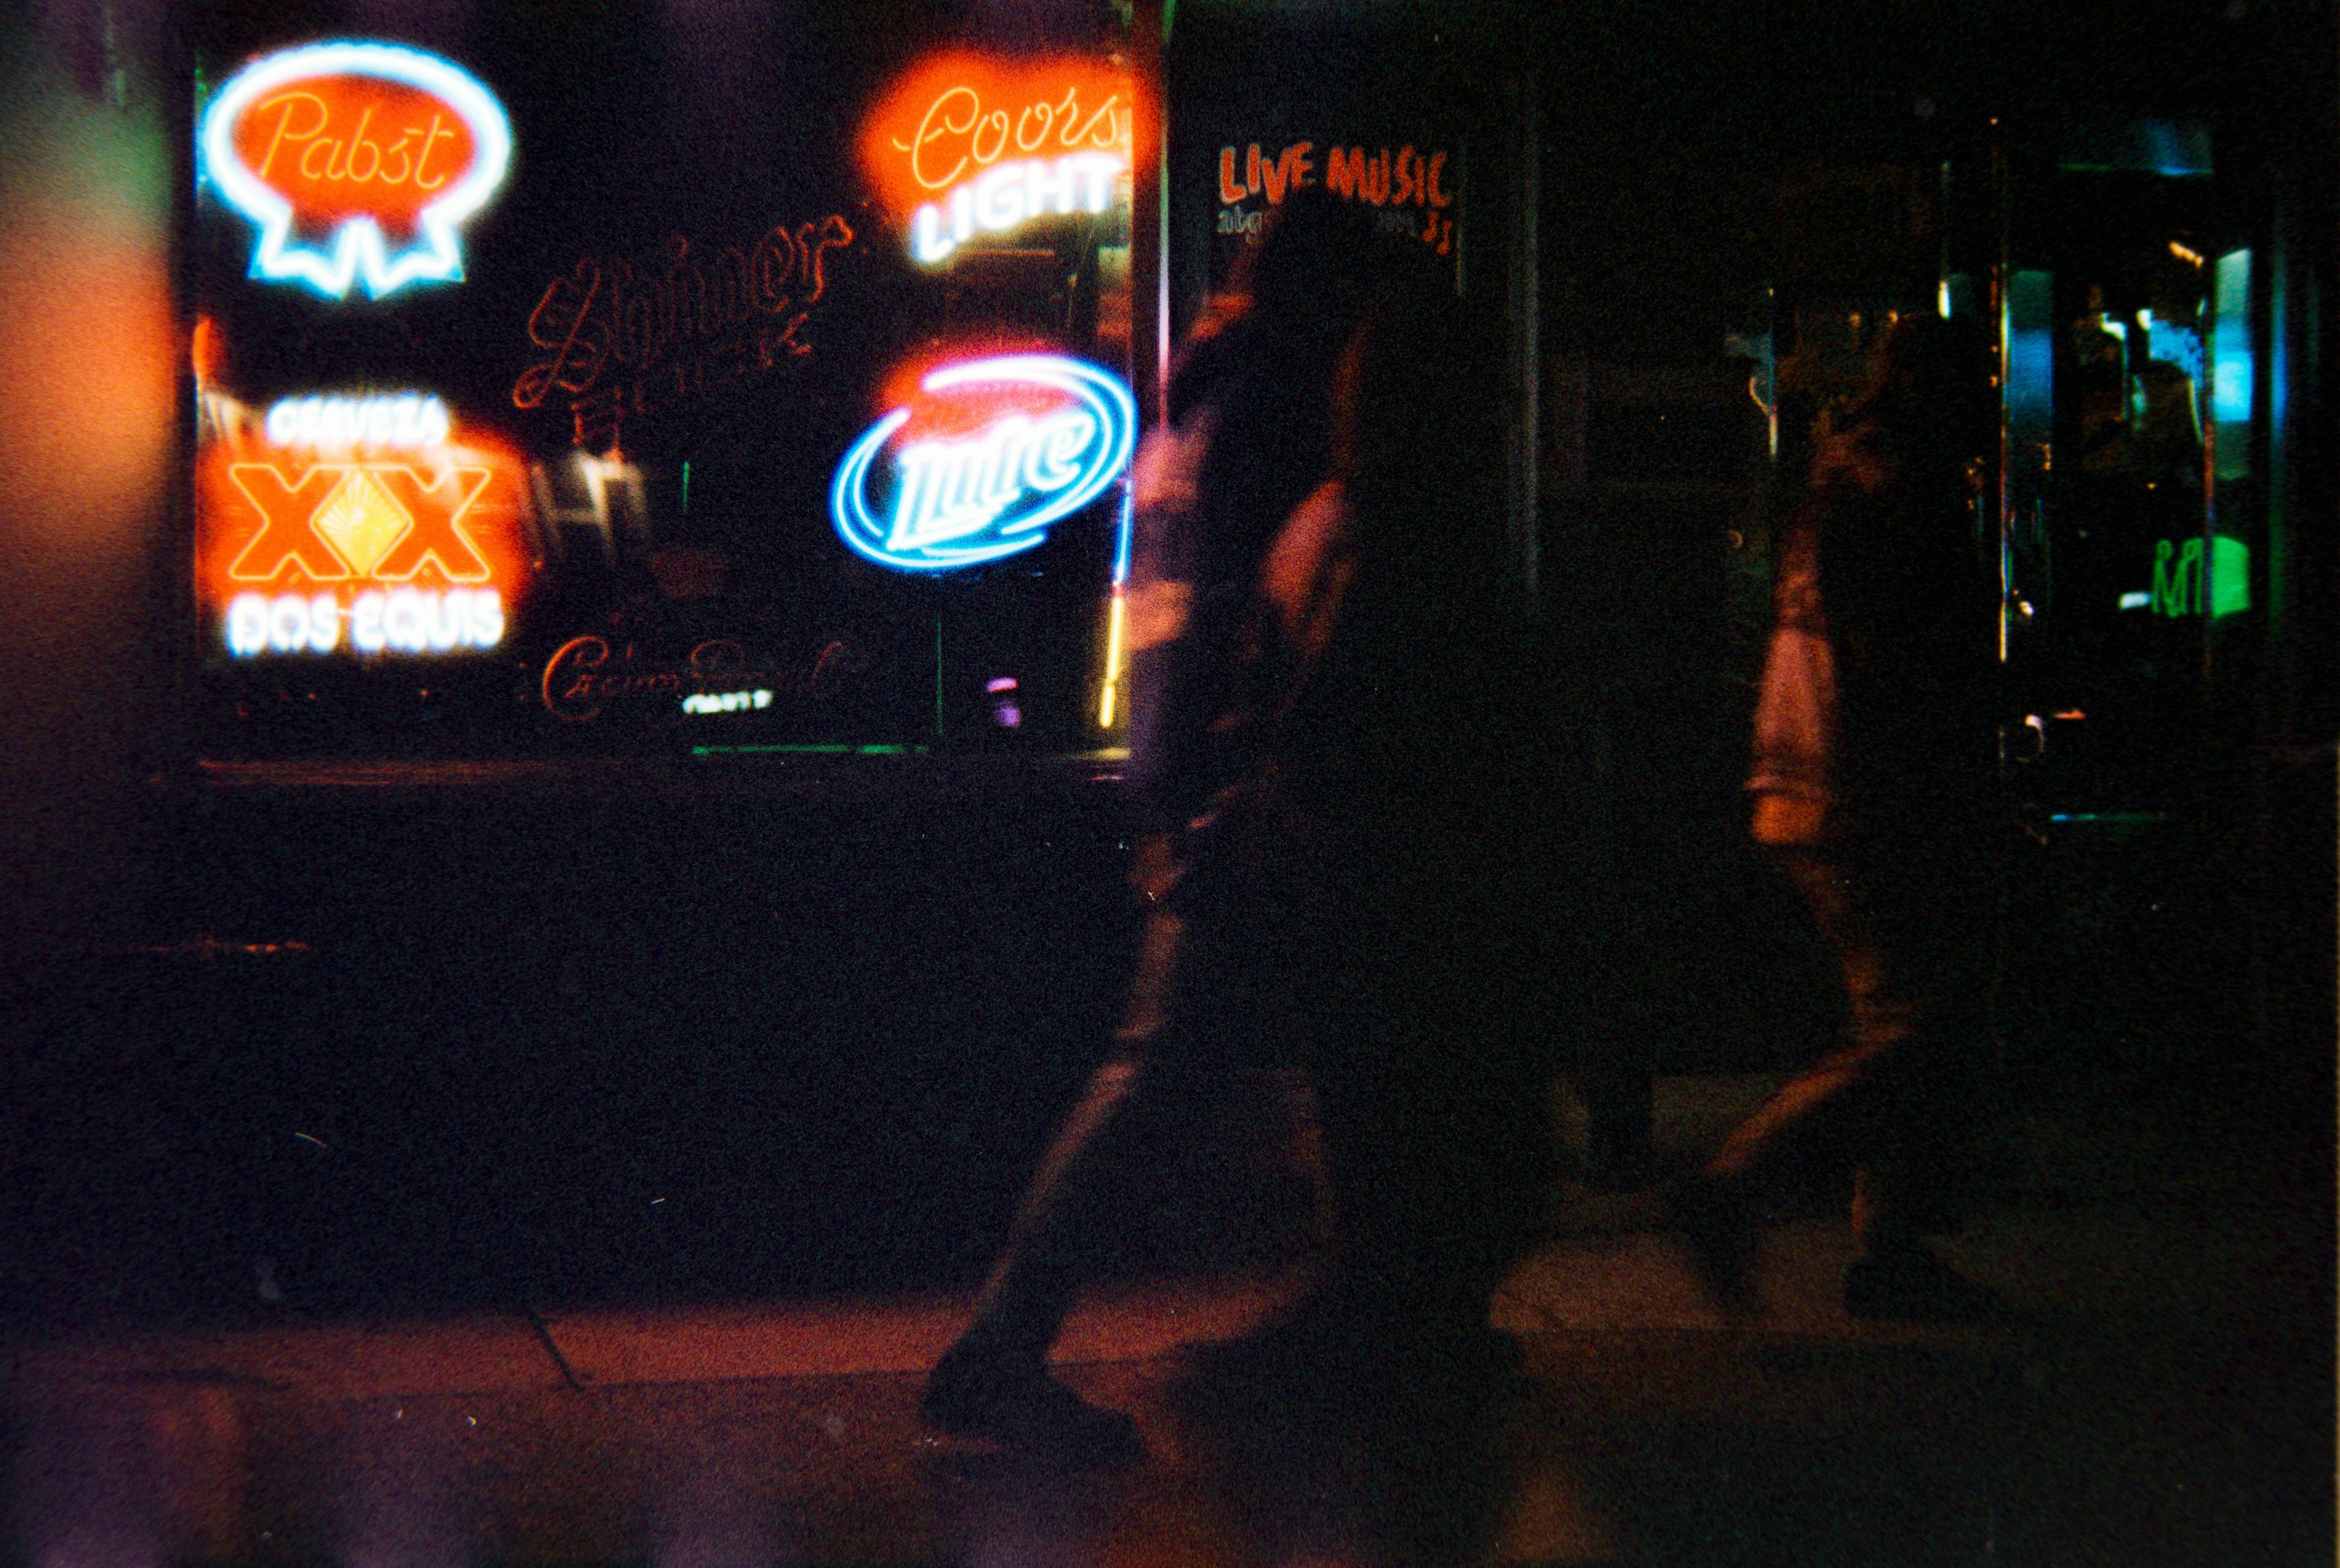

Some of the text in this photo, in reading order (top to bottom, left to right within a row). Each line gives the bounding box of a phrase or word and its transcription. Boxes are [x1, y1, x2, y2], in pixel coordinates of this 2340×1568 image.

[258, 92, 455, 190] Pabst
[892, 86, 1119, 189] Coors
[1219, 141, 1453, 208] LIVE MUSIC
[912, 152, 1125, 263] LIGHT
[266, 395, 448, 448] CERVEZA
[226, 586, 504, 658] DOS EQUIS
